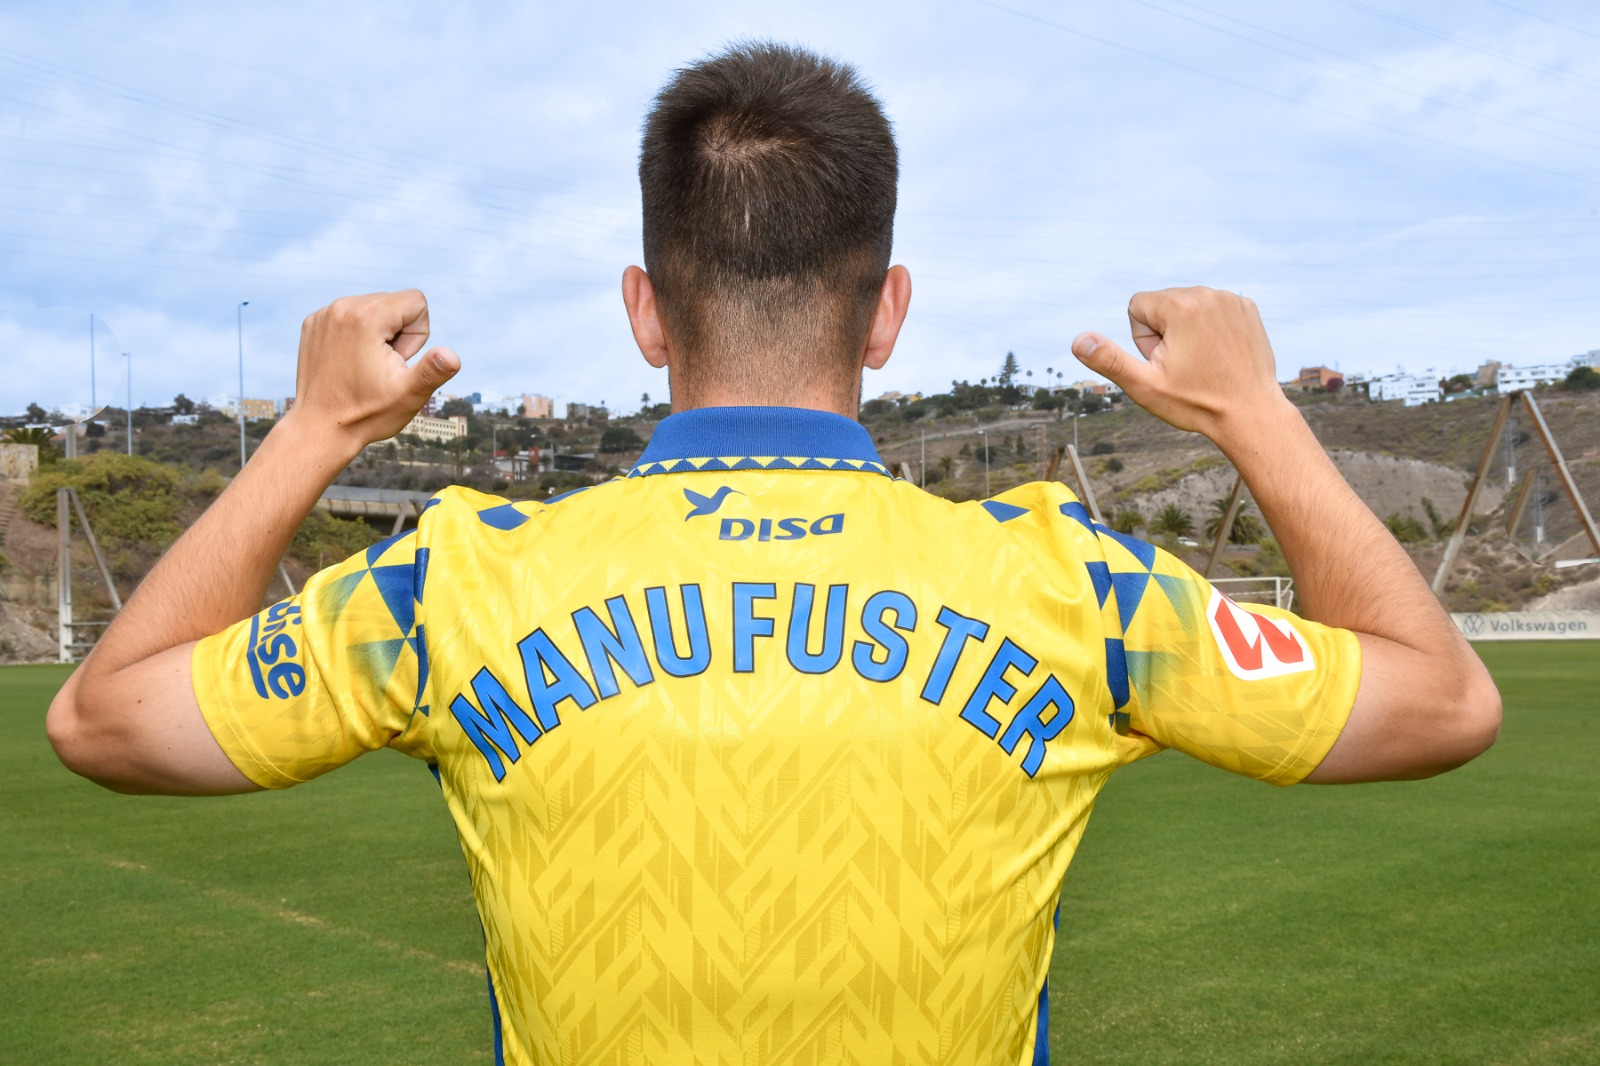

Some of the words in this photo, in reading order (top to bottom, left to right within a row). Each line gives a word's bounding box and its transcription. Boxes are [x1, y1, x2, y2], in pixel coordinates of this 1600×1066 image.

[1490, 619, 1587, 634] Volkswagen
[449, 583, 712, 783] MANU
[732, 582, 1075, 779] FUSTER
